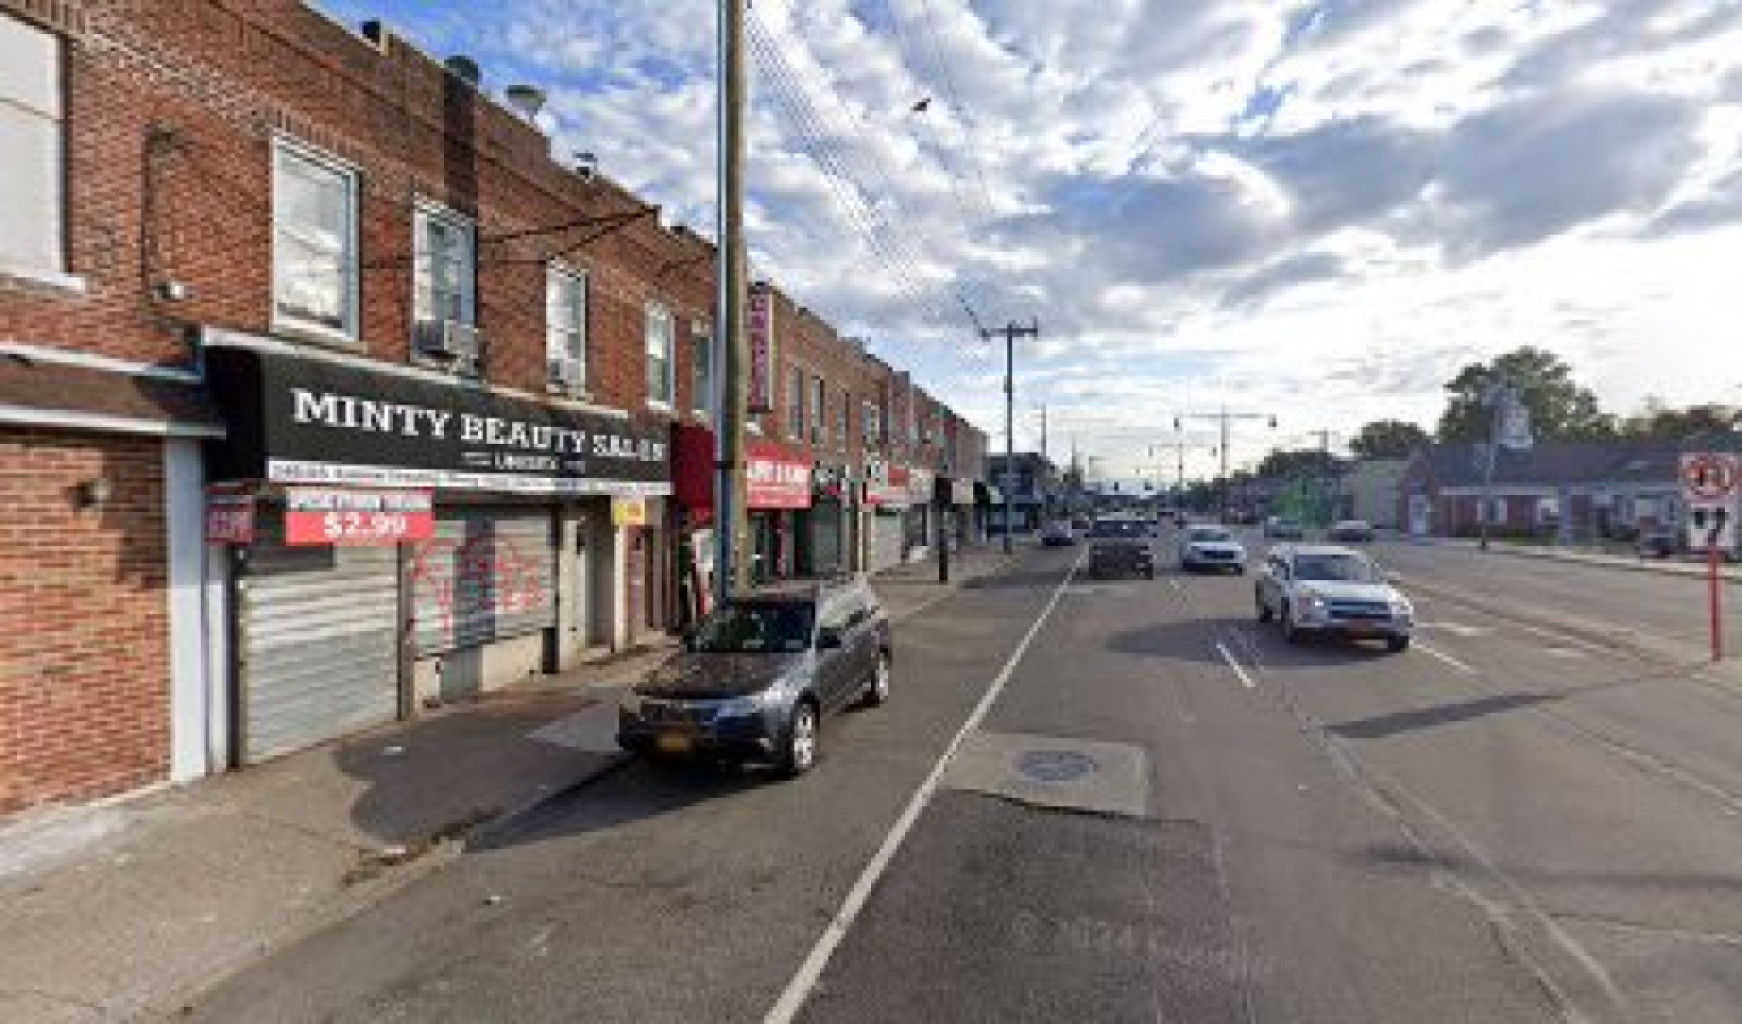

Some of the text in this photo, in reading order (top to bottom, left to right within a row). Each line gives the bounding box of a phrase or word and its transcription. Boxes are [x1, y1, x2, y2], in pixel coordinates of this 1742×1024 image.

[290, 387, 451, 439] MINTY
[460, 412, 586, 454] BEAUTY
[323, 510, 408, 539] $2.99
